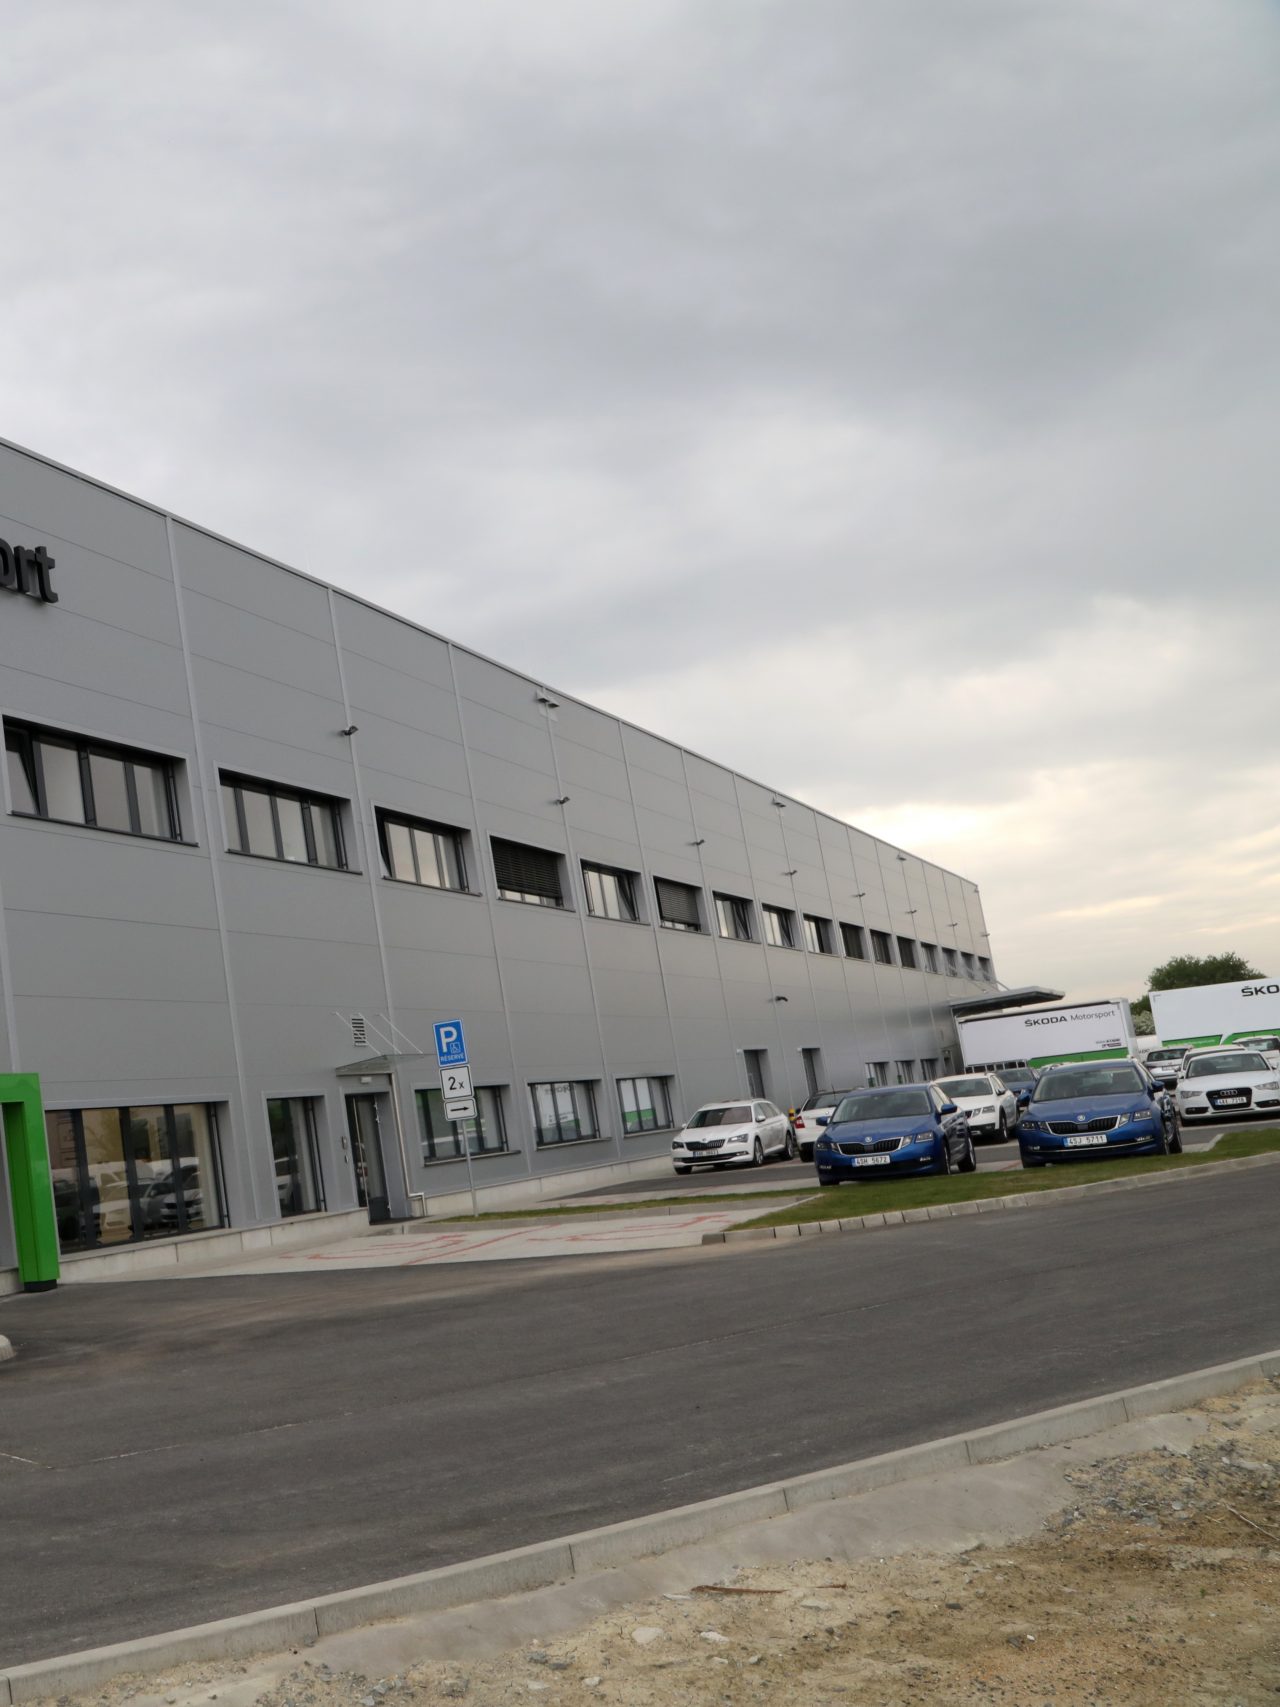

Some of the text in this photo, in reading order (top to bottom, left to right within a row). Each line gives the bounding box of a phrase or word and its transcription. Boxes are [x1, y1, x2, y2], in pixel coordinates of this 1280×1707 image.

[1024, 1009, 1116, 1028] ŠKODA Motorsport
[440, 1026, 458, 1053] P
